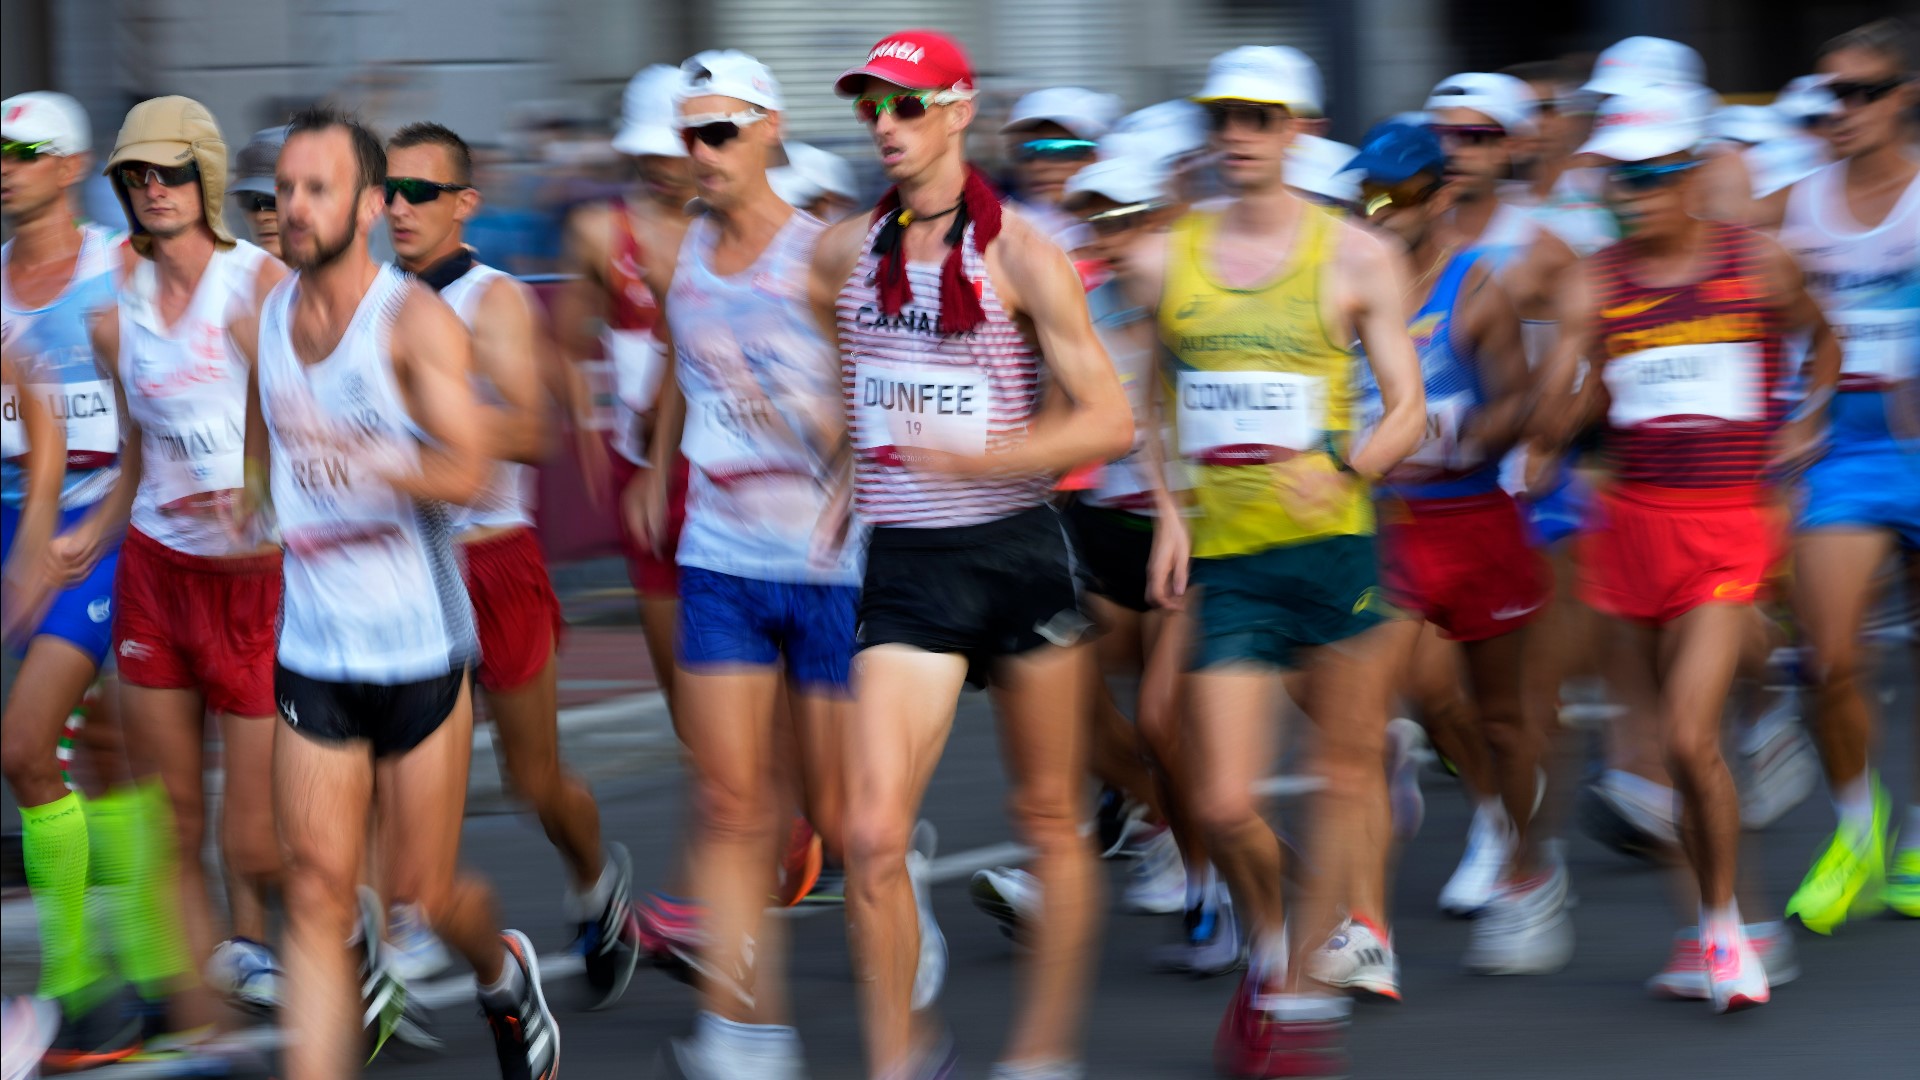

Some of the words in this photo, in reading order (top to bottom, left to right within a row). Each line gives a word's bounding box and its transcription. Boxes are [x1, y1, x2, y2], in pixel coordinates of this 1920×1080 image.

[865, 41, 925, 65] ANADA
[863, 376, 974, 416] DUNFEE
[1184, 382, 1299, 412] COWLEY
[905, 420, 922, 436] 19
